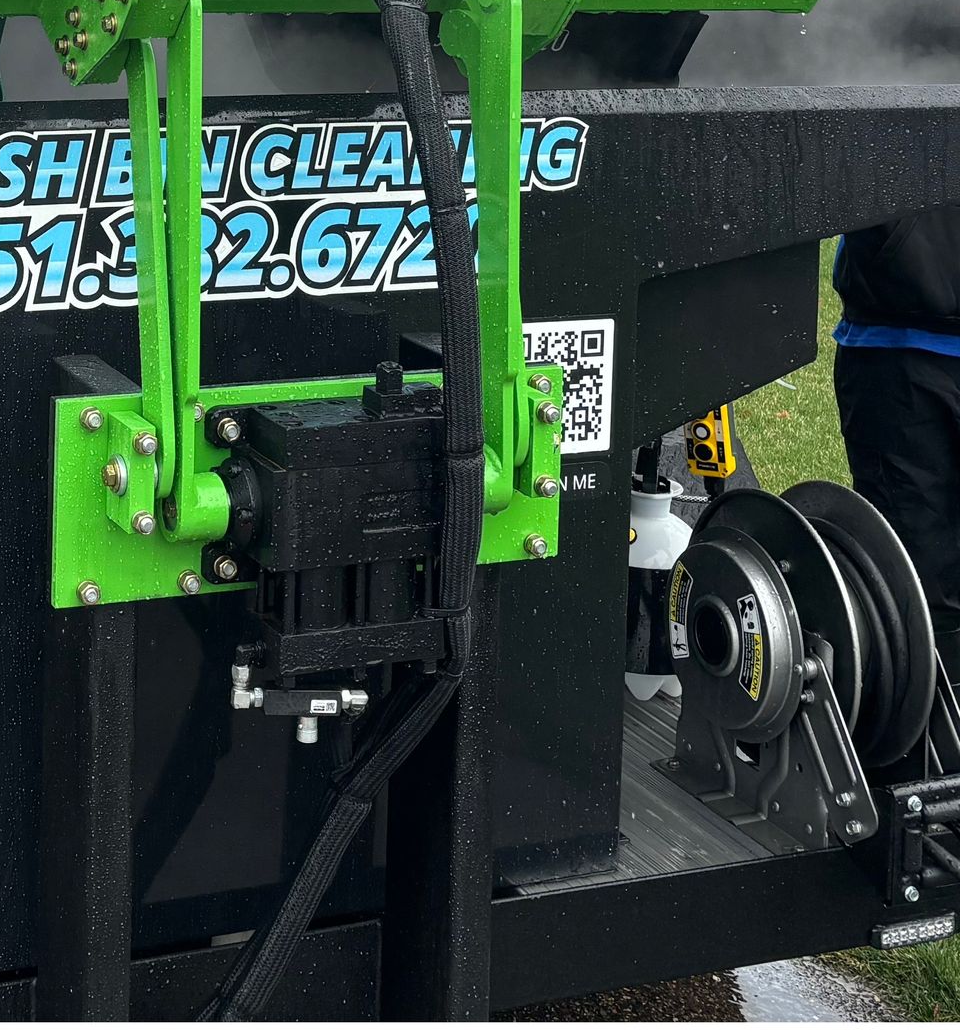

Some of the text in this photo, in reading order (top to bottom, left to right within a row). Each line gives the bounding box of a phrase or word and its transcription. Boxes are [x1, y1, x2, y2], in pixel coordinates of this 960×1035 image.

[97, 130, 235, 203] BN
[246, 120, 583, 197] CLEAG
[572, 473, 596, 491] ME
[751, 648, 761, 694] CAUTION
